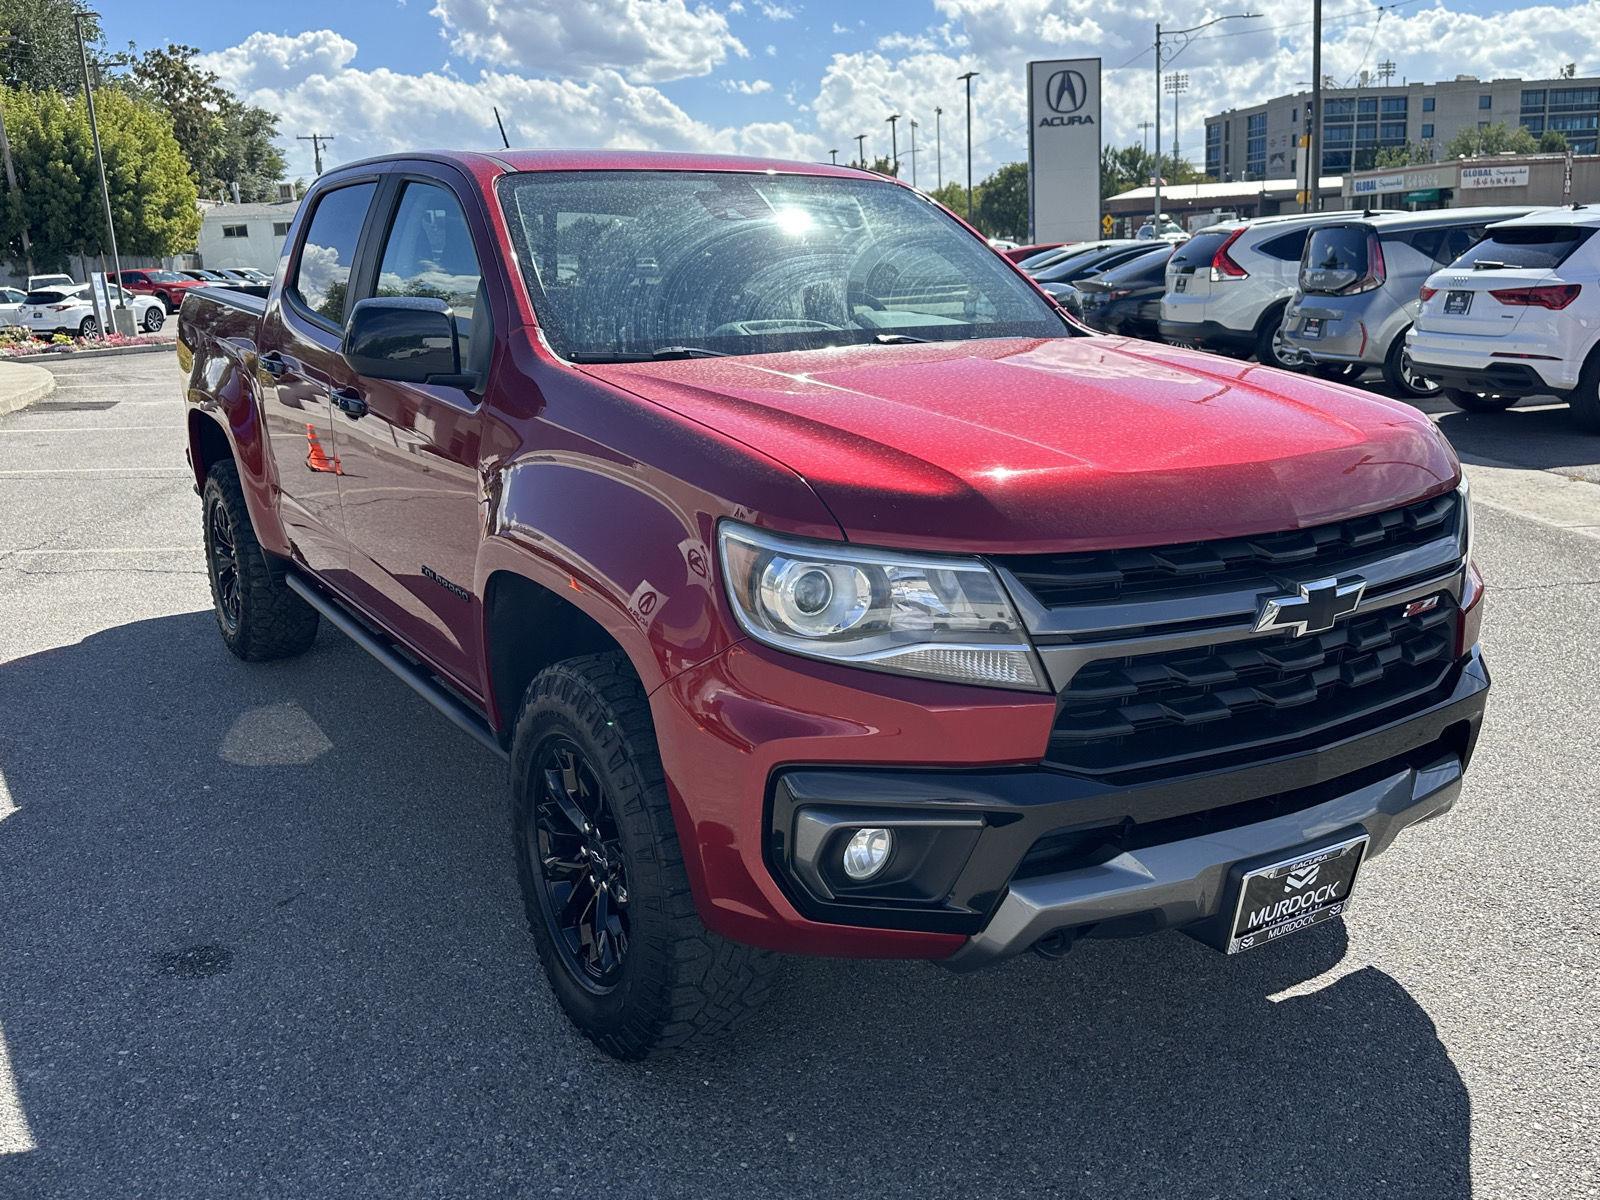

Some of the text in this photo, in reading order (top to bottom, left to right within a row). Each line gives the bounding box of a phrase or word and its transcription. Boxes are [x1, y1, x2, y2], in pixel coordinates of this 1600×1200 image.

[1039, 115, 1094, 127] ACURA
[1462, 169, 1492, 178] GLOBAL
[1355, 180, 1377, 192] GLOBAL
[1297, 854, 1328, 867] ACURA
[1247, 880, 1341, 929] MURDOCK
[1267, 913, 1317, 939] MURDOCK
